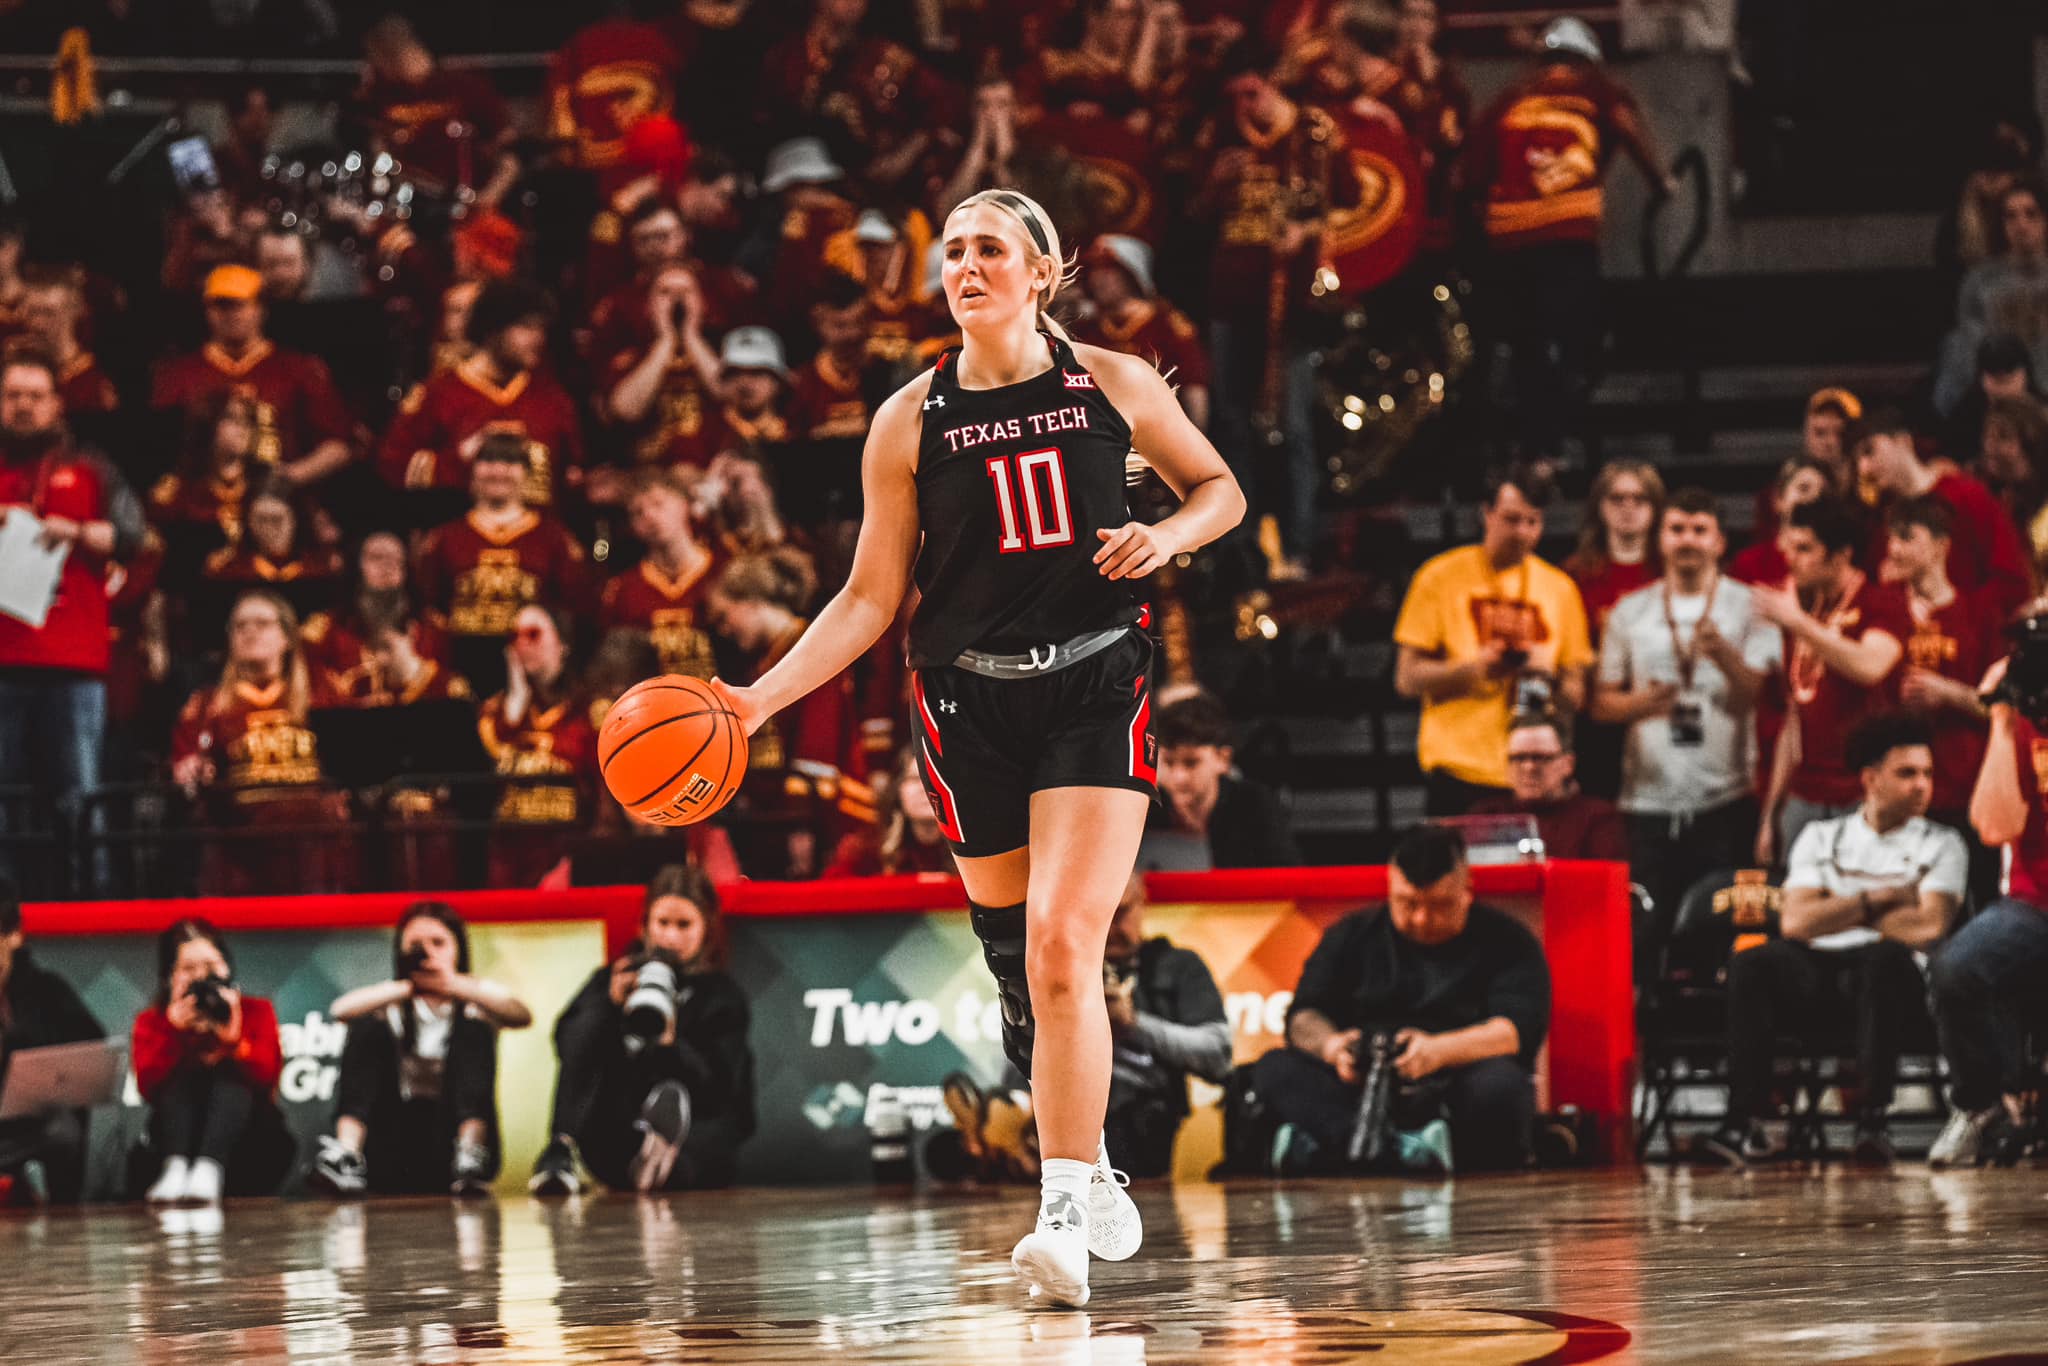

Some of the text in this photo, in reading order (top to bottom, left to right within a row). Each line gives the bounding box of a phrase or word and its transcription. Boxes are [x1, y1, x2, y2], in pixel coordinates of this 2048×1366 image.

[944, 407, 1089, 452] TEXAS TECH
[986, 447, 1075, 554] 10
[647, 776, 715, 823] ELITE
[803, 987, 940, 1046] Two
